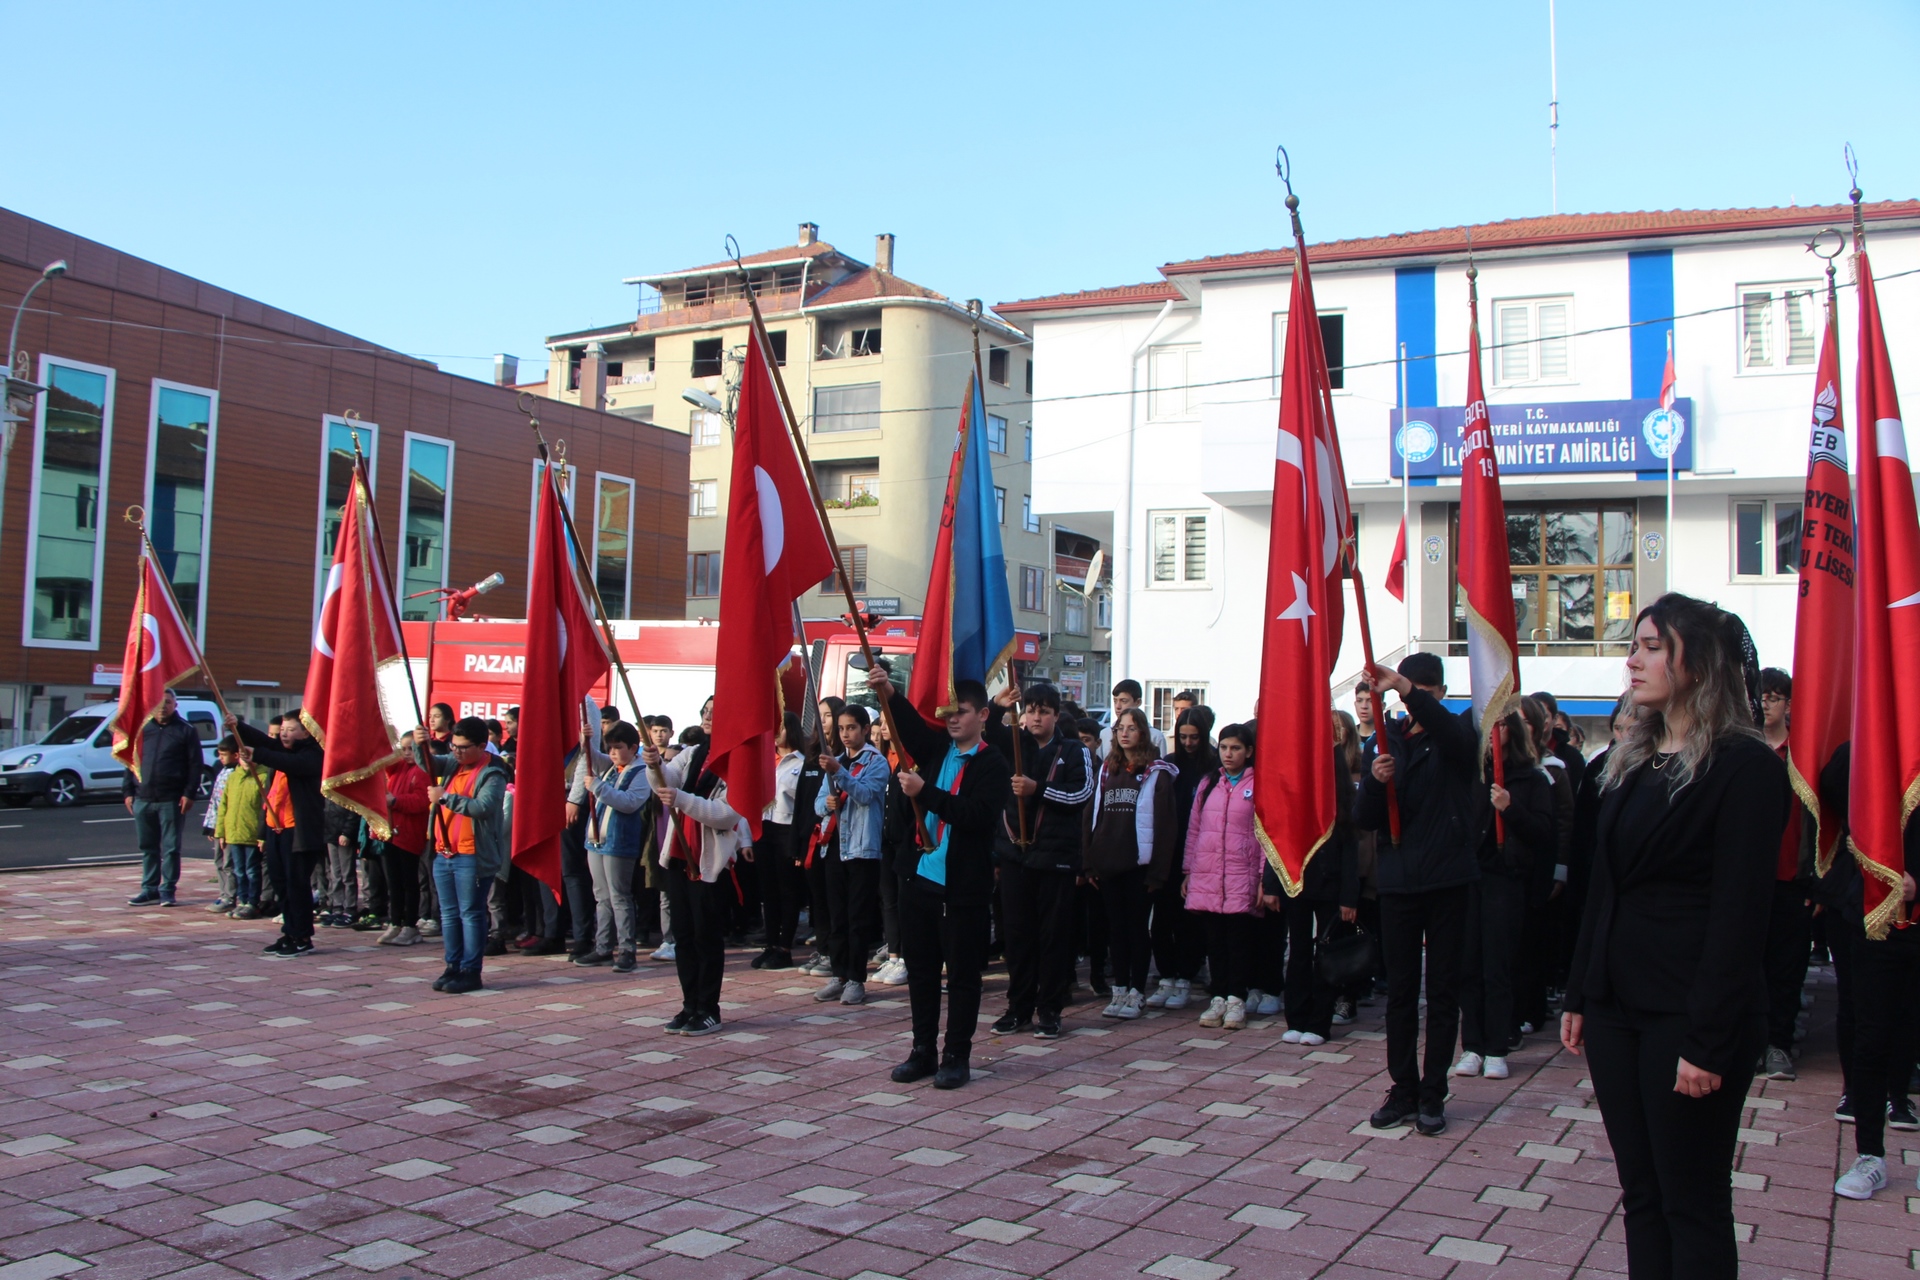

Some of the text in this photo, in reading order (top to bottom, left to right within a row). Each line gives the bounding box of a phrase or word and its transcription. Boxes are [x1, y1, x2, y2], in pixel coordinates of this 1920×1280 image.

[1526, 408, 1548, 420] T.C.
[1457, 419, 1620, 437] PRYERİ KAYMAKAMLIĞI
[1812, 430, 1838, 451] EB
[1494, 440, 1555, 465] MNİYET
[1560, 436, 1636, 464] AMİRLİĞİ
[459, 701, 521, 721] BELE
[1104, 789, 1114, 806] OS
